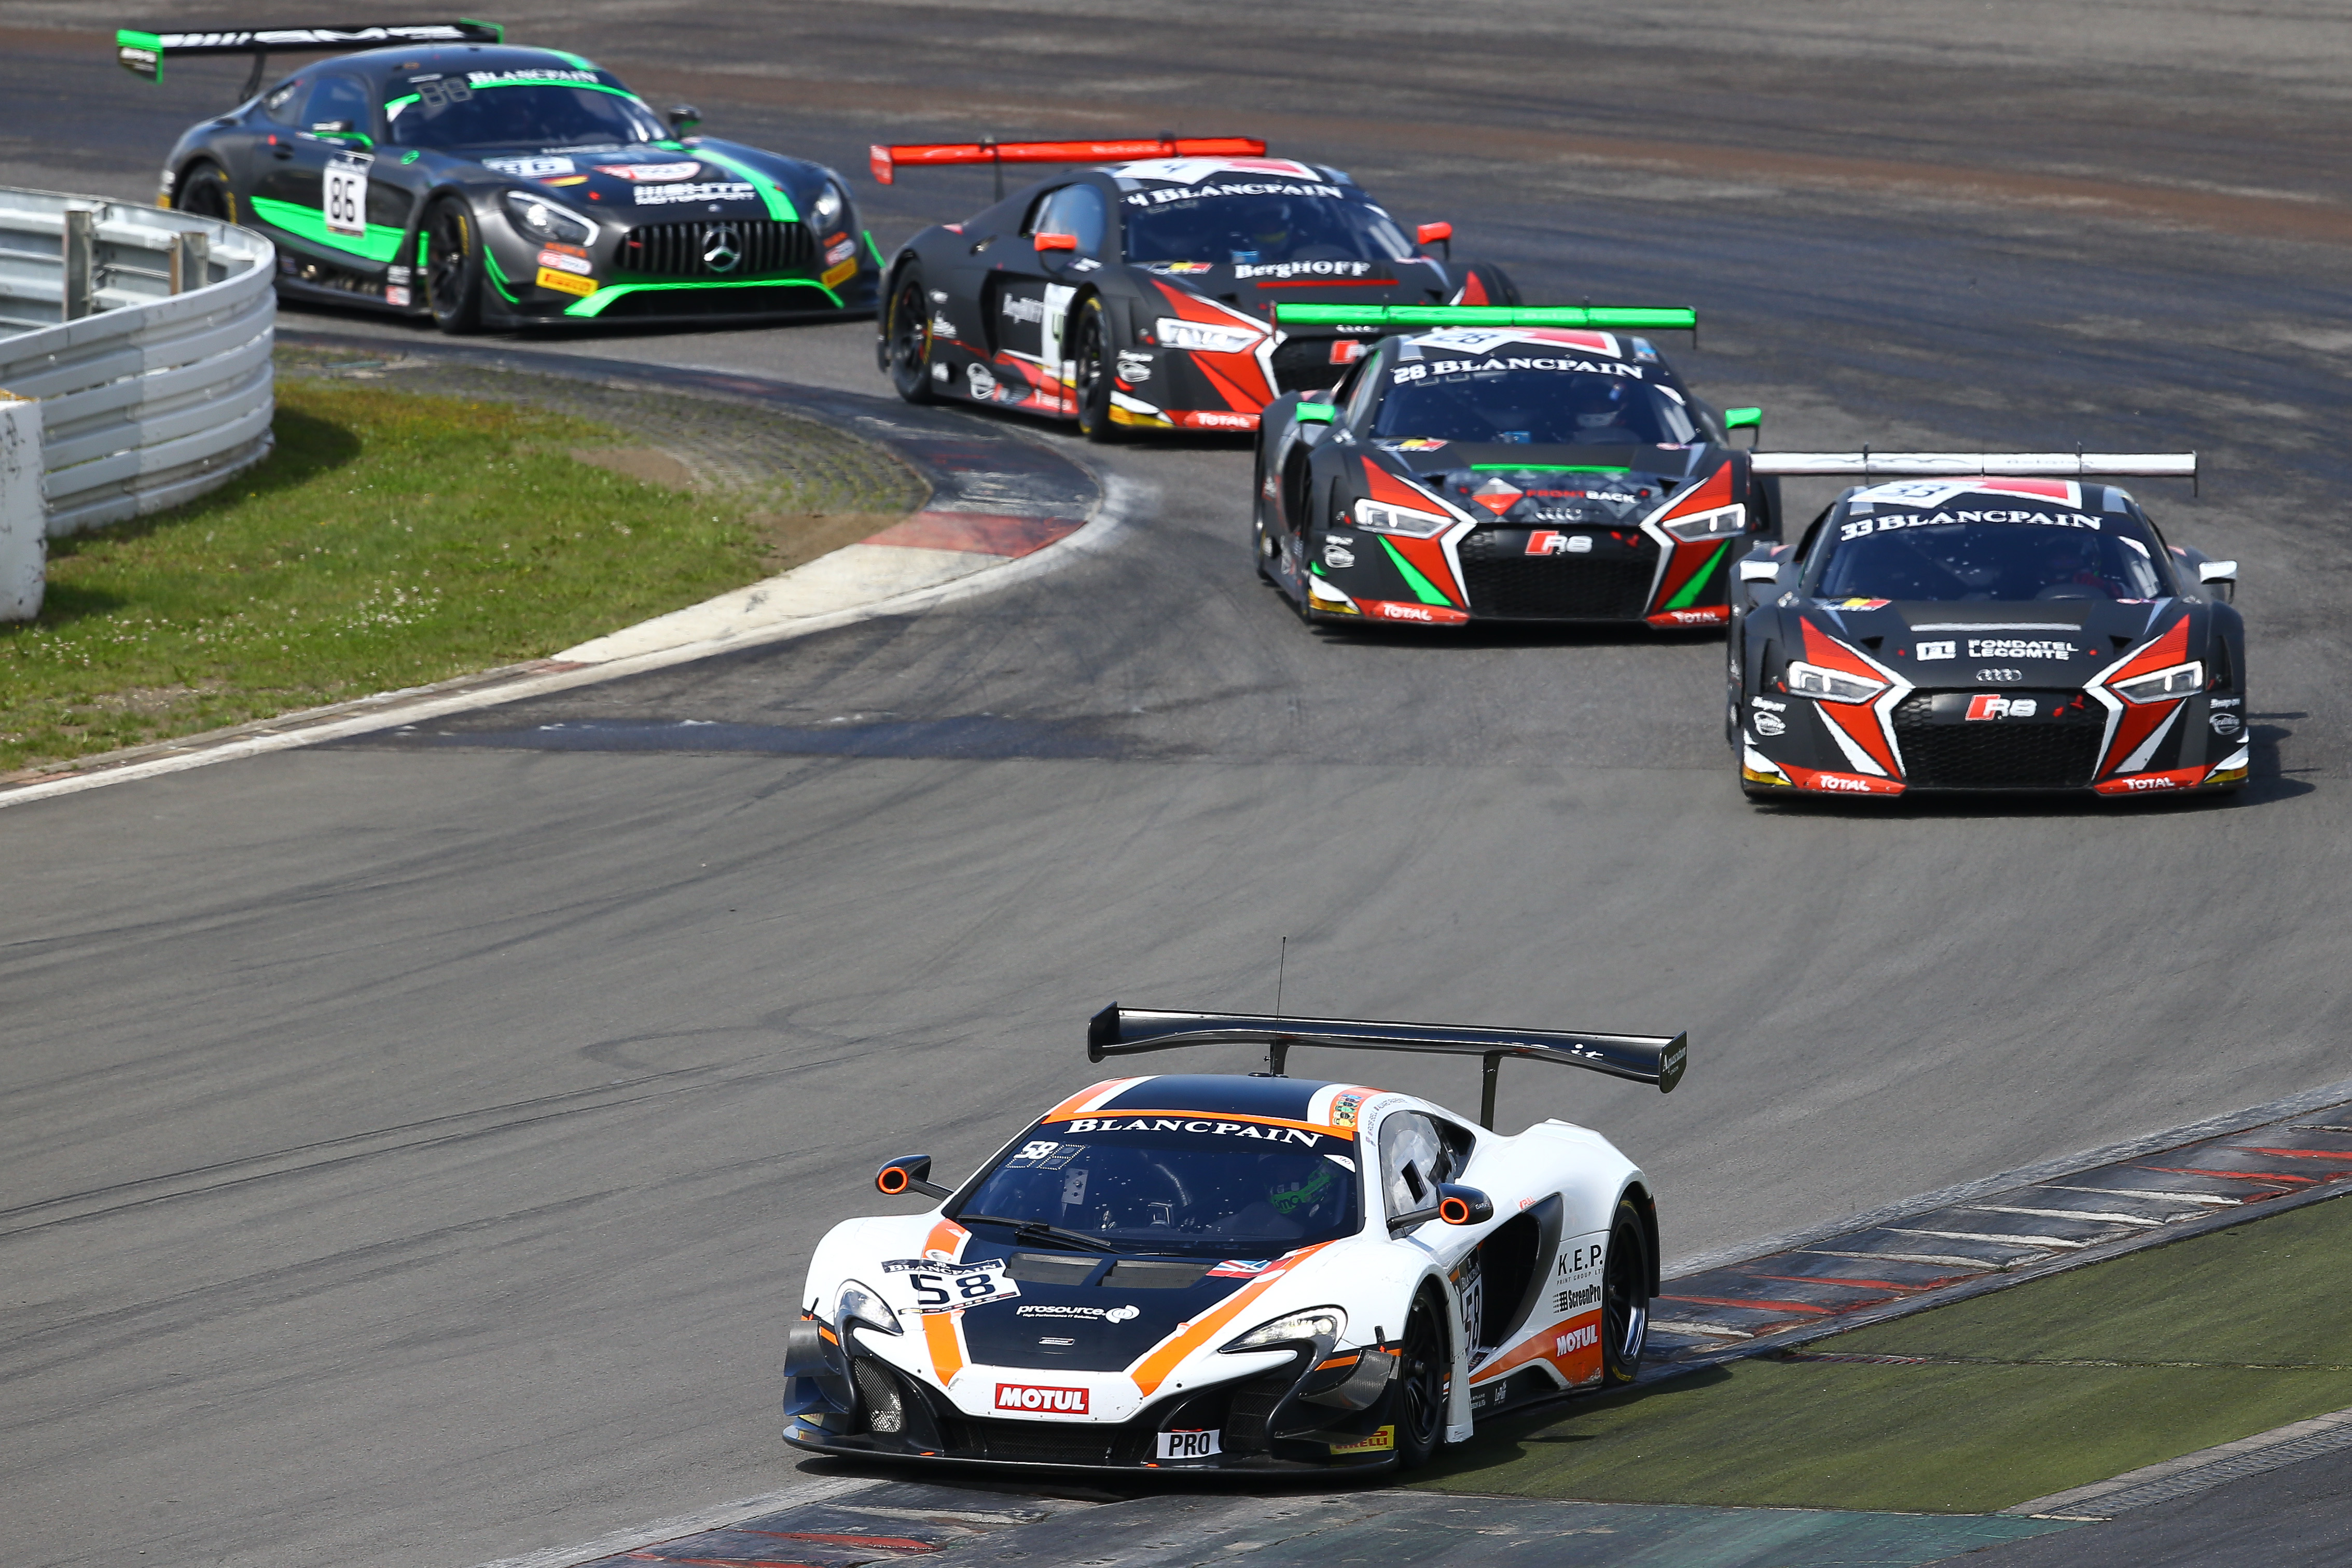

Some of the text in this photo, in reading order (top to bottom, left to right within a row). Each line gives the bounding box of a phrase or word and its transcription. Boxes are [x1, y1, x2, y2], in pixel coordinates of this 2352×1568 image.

[332, 177, 355, 222] 86
[1150, 183, 1343, 204] BLANCPAIN
[1235, 260, 1371, 279] BergHOFF
[1393, 358, 1643, 384] 28 BLANCPAIN
[1196, 413, 1250, 428] TOTAL
[1841, 510, 2102, 541] 33 BLANCPAIN
[1542, 534, 1593, 553] R8
[1383, 604, 1432, 621] TOTAL
[1670, 610, 1721, 623] TOTAL
[1968, 639, 2079, 651] FONDATEL
[1968, 648, 2070, 660] LECOMTE
[1983, 698, 2038, 717] R8
[1820, 774, 1871, 792] TOTAL
[2122, 777, 2175, 790] TOTAL
[1063, 1118, 1324, 1148] BLANCPAIN
[1013, 1141, 1059, 1160] 58
[888, 1264, 998, 1275] BLANCPAIN
[1558, 1244, 1603, 1276] K.E.P.
[1556, 1277, 1571, 1286] PRINT
[1573, 1271, 1592, 1281] GROUP
[909, 1274, 996, 1305] 58
[1568, 1284, 1601, 1309] ScreenPro
[1556, 1324, 1598, 1357] MOTUL
[998, 1386, 1086, 1410] MOTUL
[1168, 1433, 1211, 1456] PRO
